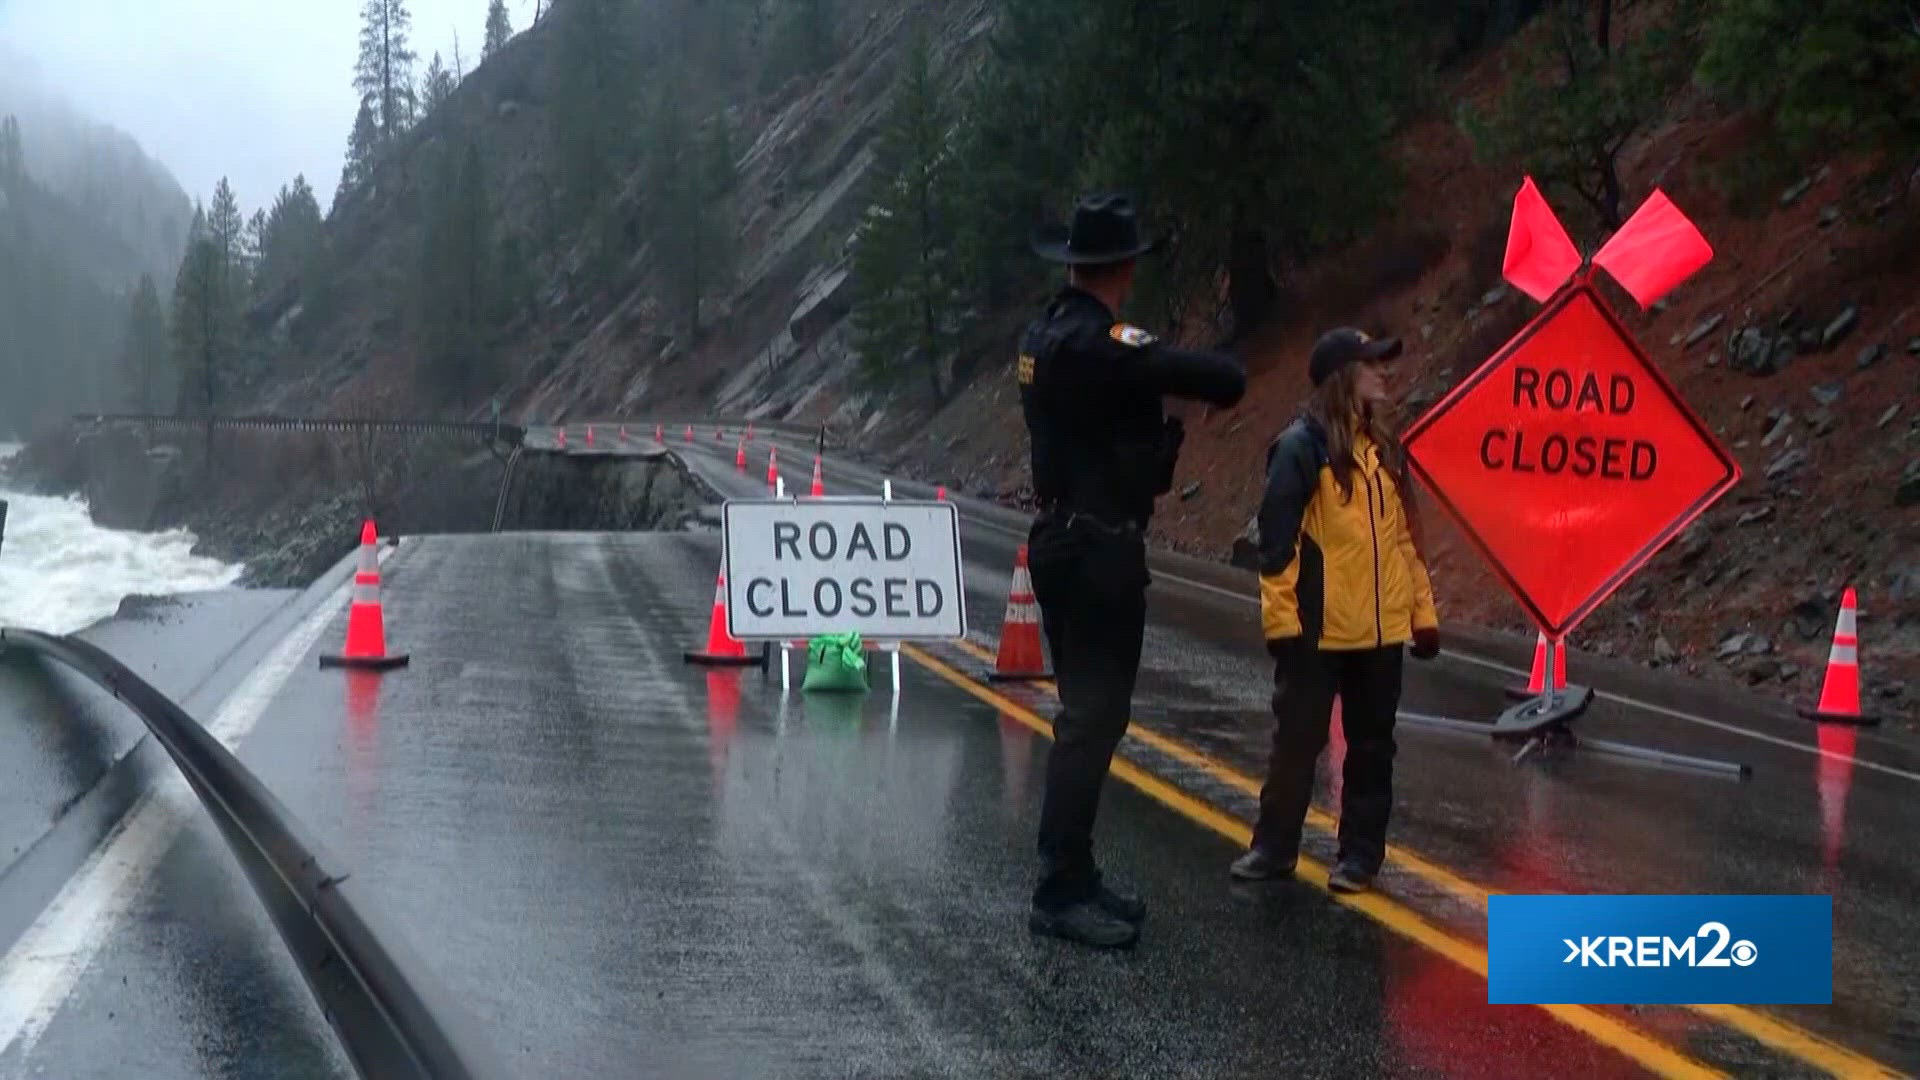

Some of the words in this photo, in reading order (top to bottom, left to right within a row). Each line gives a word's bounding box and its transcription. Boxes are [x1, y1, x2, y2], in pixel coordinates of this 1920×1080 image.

[1512, 366, 1636, 416] ROAD
[1479, 429, 1658, 482] CLOSED
[773, 520, 912, 562] ROAD
[746, 577, 944, 618] CLOSED
